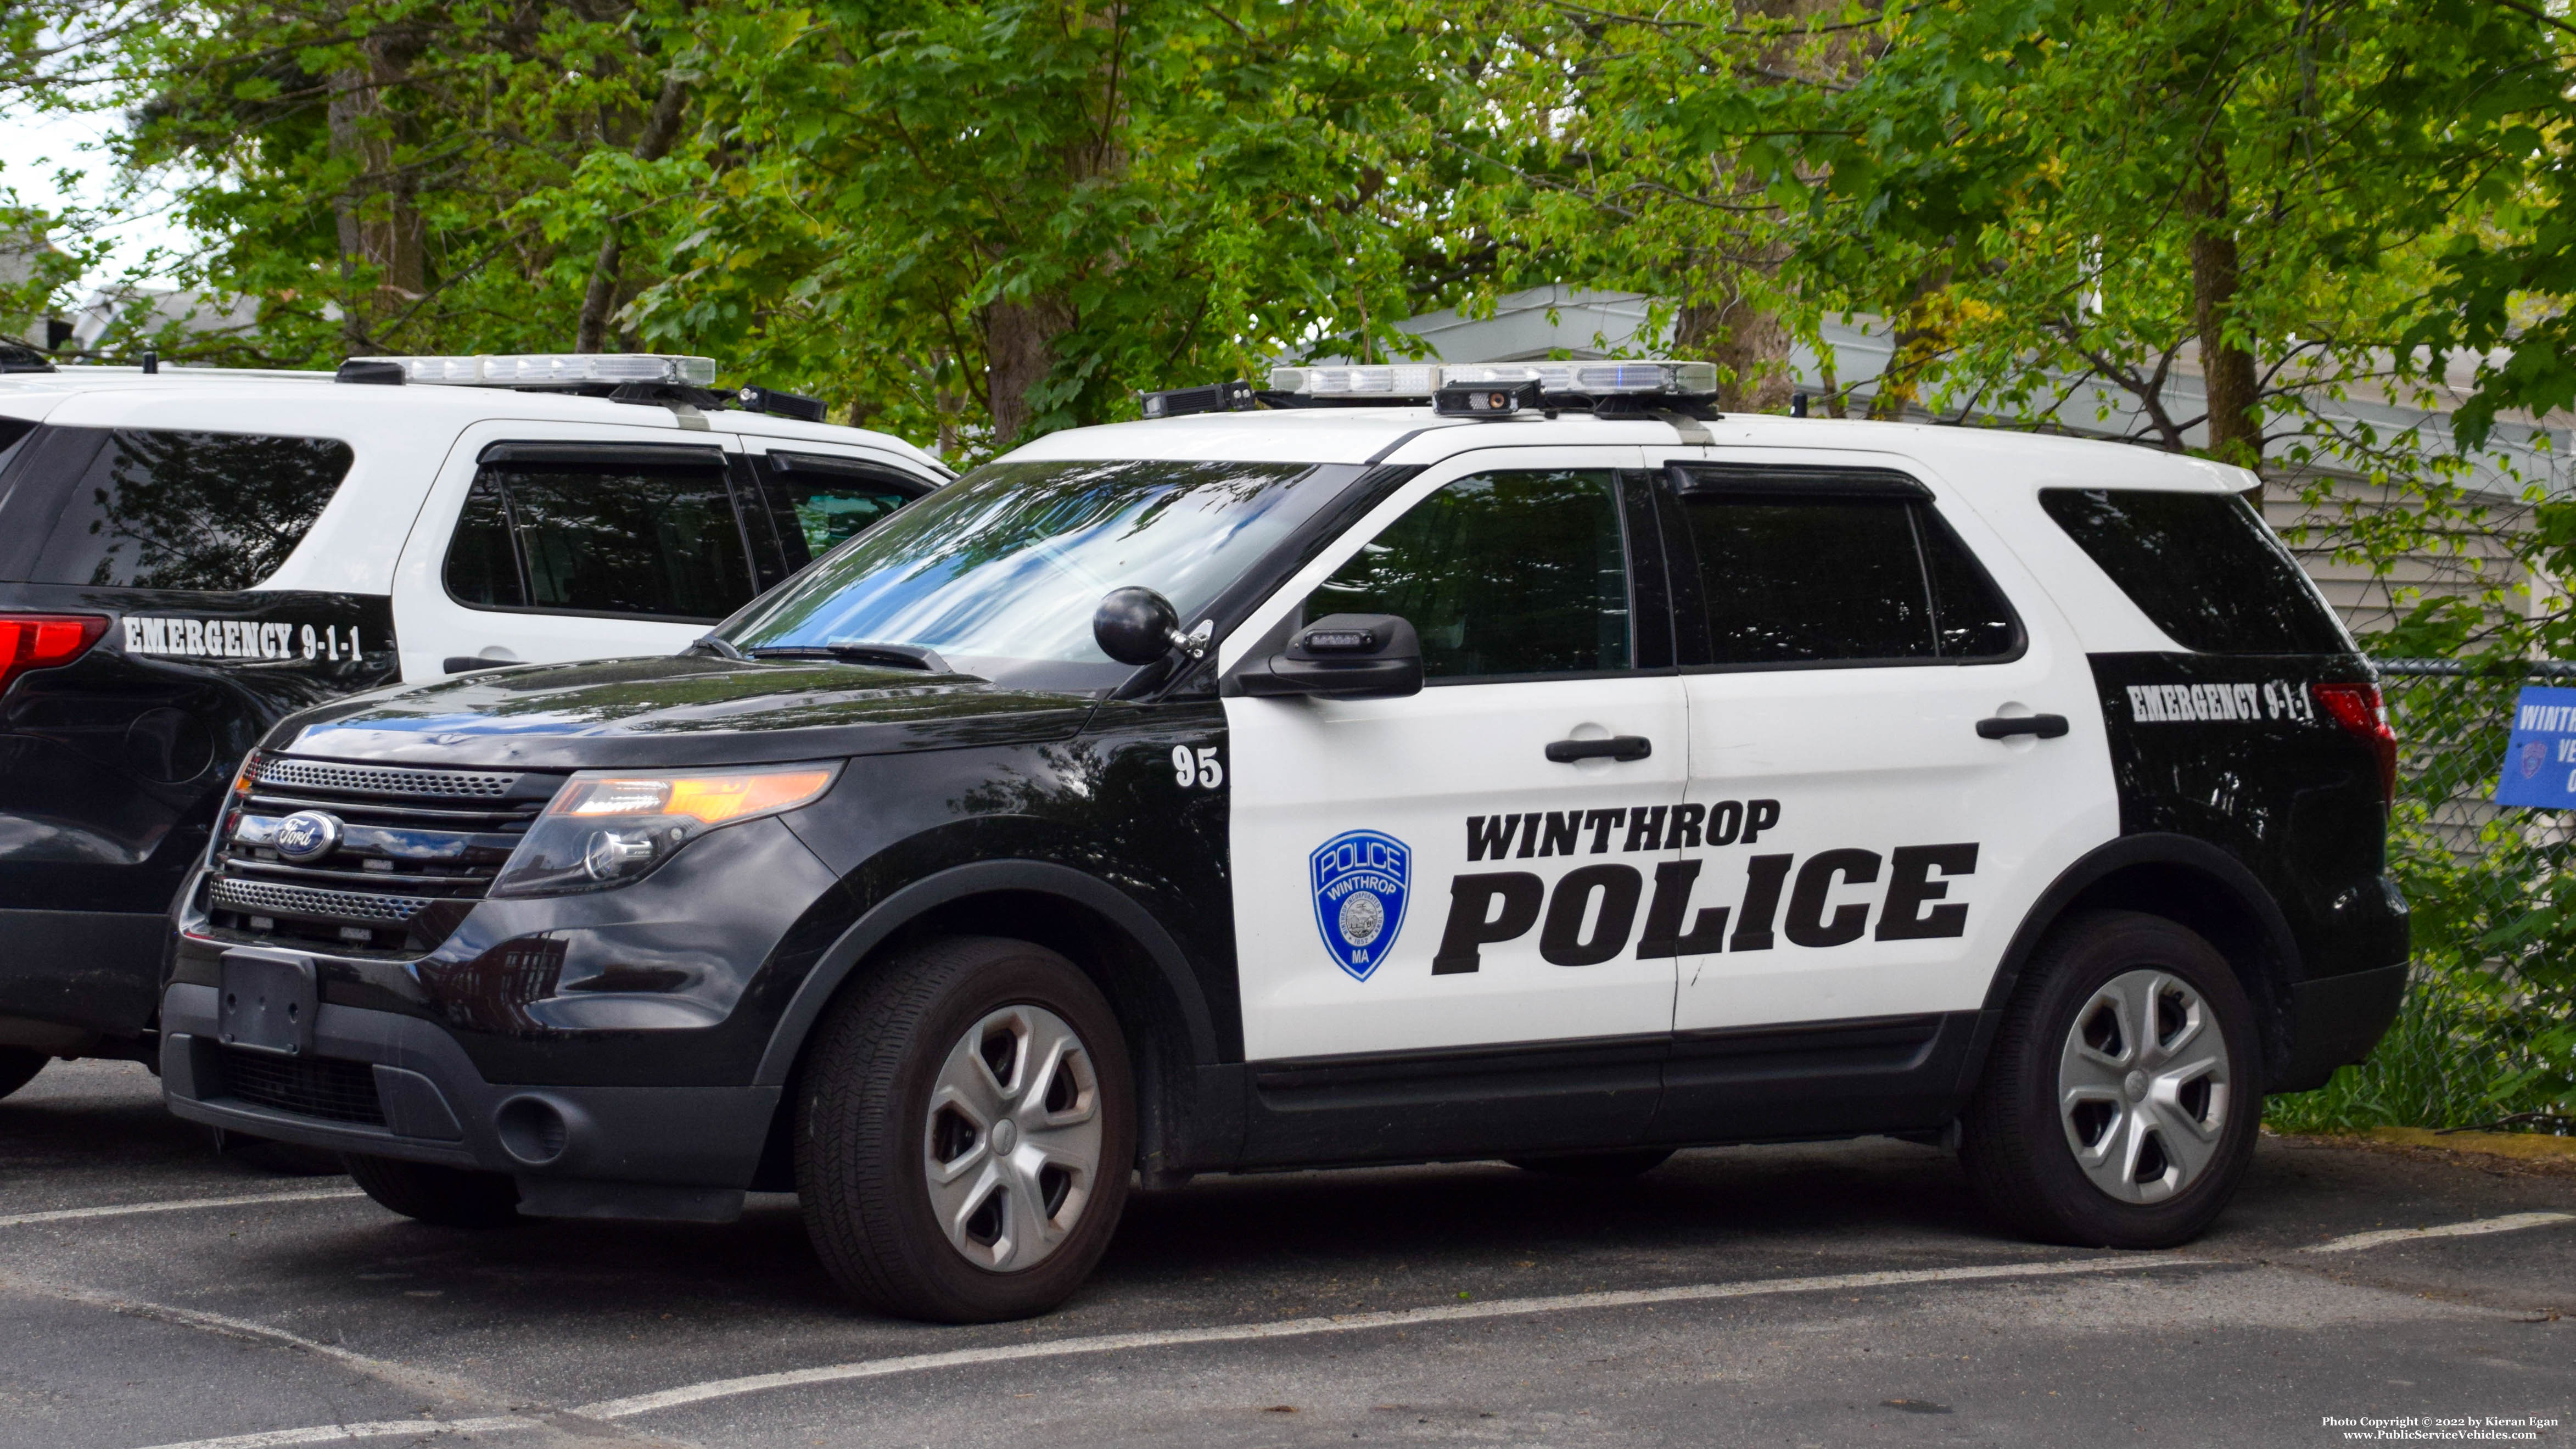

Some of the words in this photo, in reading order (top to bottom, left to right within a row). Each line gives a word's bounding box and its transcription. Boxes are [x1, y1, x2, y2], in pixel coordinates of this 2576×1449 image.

[122, 617, 293, 659] EMERGENCY
[301, 624, 363, 661] 9-1-1
[2126, 684, 2261, 722] EMERGENCY
[2263, 681, 2314, 719] 9-1-1
[1172, 745, 1223, 788] 95
[279, 818, 316, 846] Ford
[1466, 799, 1780, 861] WINTHROP
[1321, 841, 1401, 883] POLICE
[1327, 876, 1397, 900] WINTHROP
[1431, 842, 1980, 975] POLICE
[1352, 949, 1369, 964] MA
